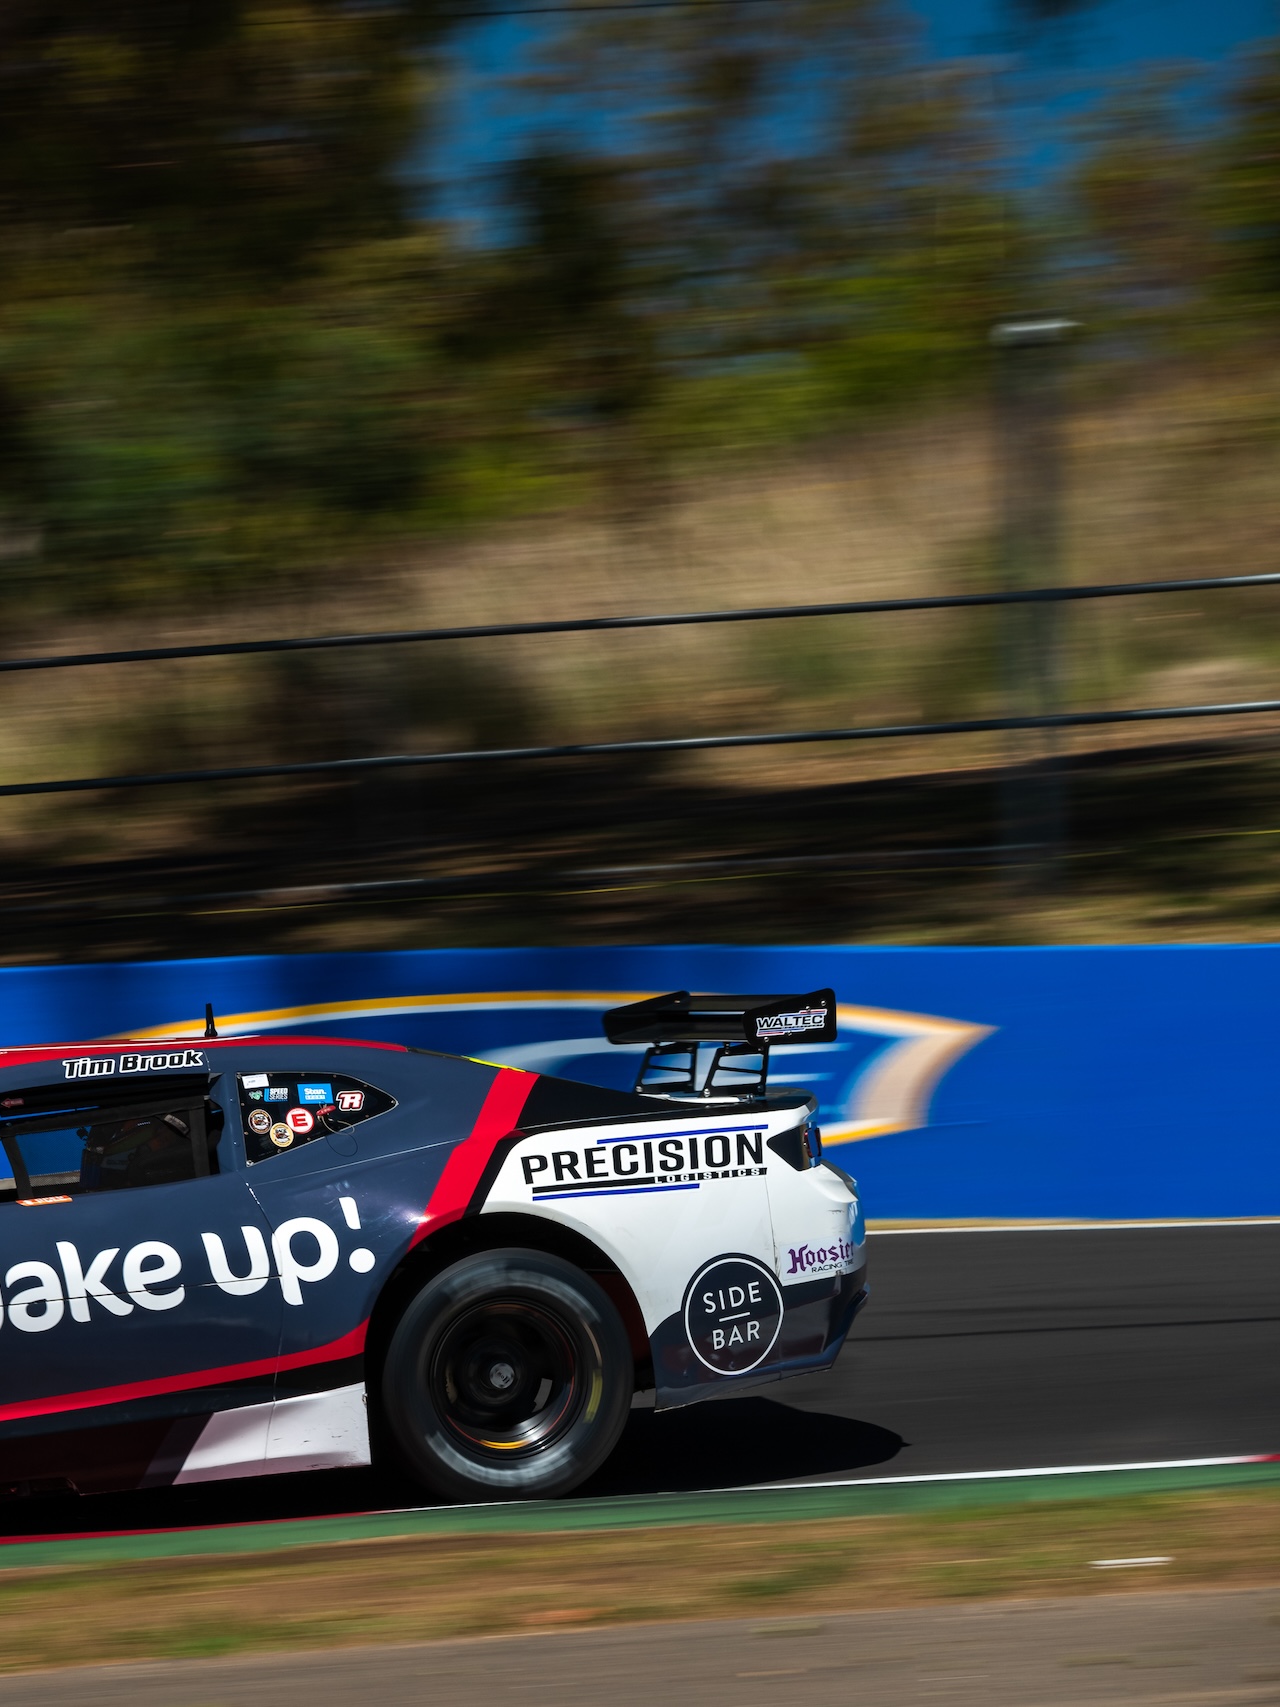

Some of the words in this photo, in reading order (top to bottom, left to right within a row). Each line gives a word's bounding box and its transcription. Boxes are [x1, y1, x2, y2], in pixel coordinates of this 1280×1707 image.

[757, 1014, 824, 1028] WALTEC
[62, 1057, 115, 1078] Tim
[120, 1049, 204, 1073] Brook
[291, 1113, 309, 1128] E
[520, 1132, 763, 1185] PRECISION
[653, 1166, 762, 1184] LOGISTICS
[200, 1196, 376, 1306] up!
[811, 1260, 843, 1273] RACING
[702, 1281, 762, 1314] SIDE
[712, 1320, 761, 1350] BAR
